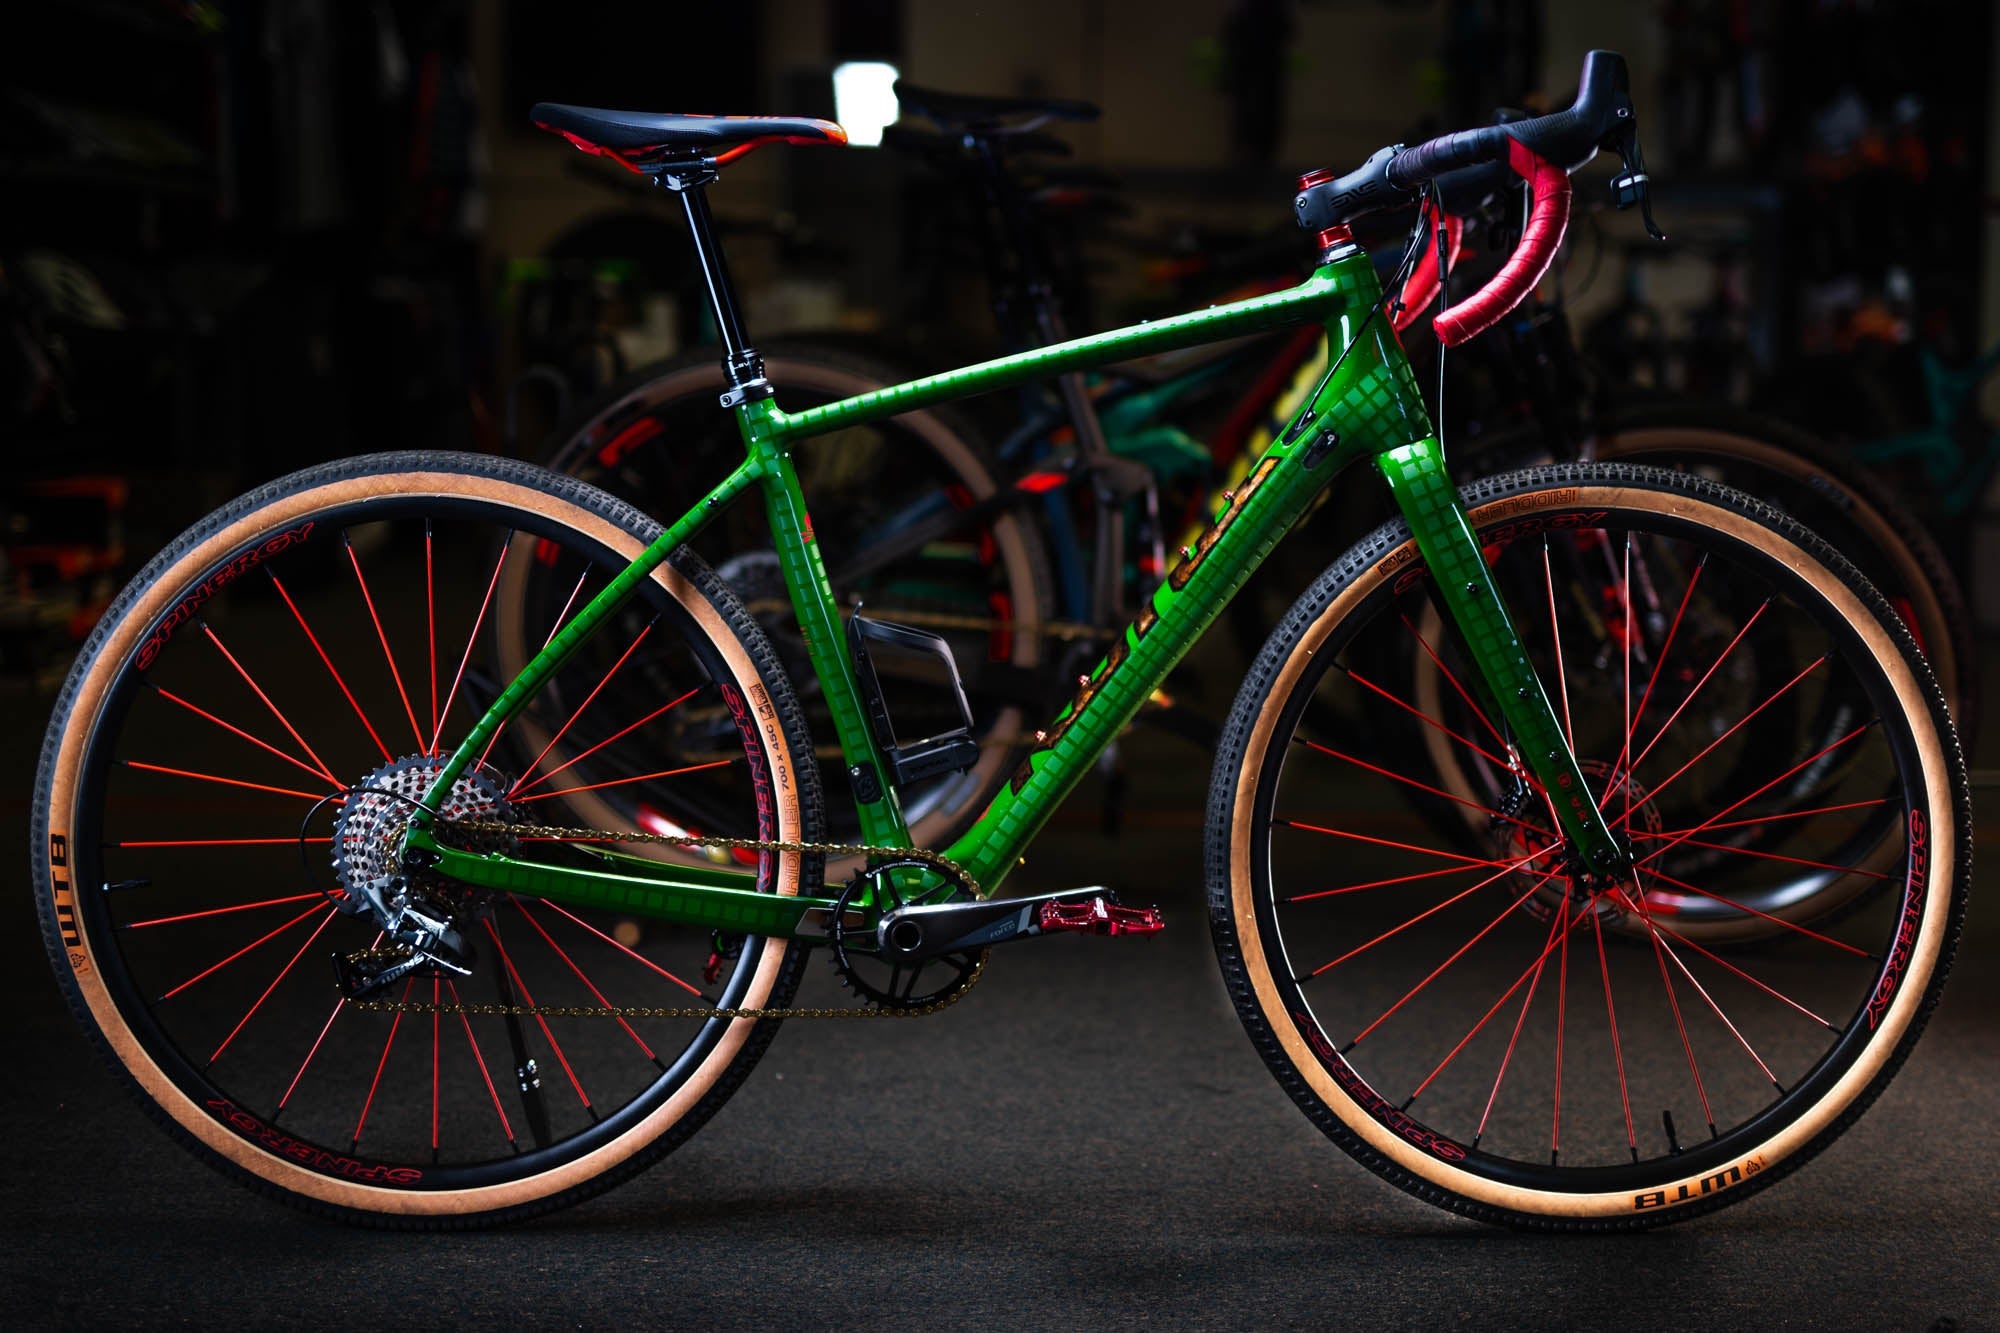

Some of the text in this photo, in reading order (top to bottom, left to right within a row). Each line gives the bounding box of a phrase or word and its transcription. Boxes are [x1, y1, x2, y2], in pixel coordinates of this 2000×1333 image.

[1477, 491, 1571, 520] RIDDLER
[134, 521, 317, 673] SPINERGY
[766, 724, 780, 751] 45C
[778, 766, 790, 791] 700
[51, 834, 81, 947] WTB
[1866, 807, 1933, 1031] SPINERGY
[1296, 1011, 1467, 1164] SPINERGY
[207, 1098, 425, 1186] SPINERGY
[1635, 1166, 1741, 1210] WTB
